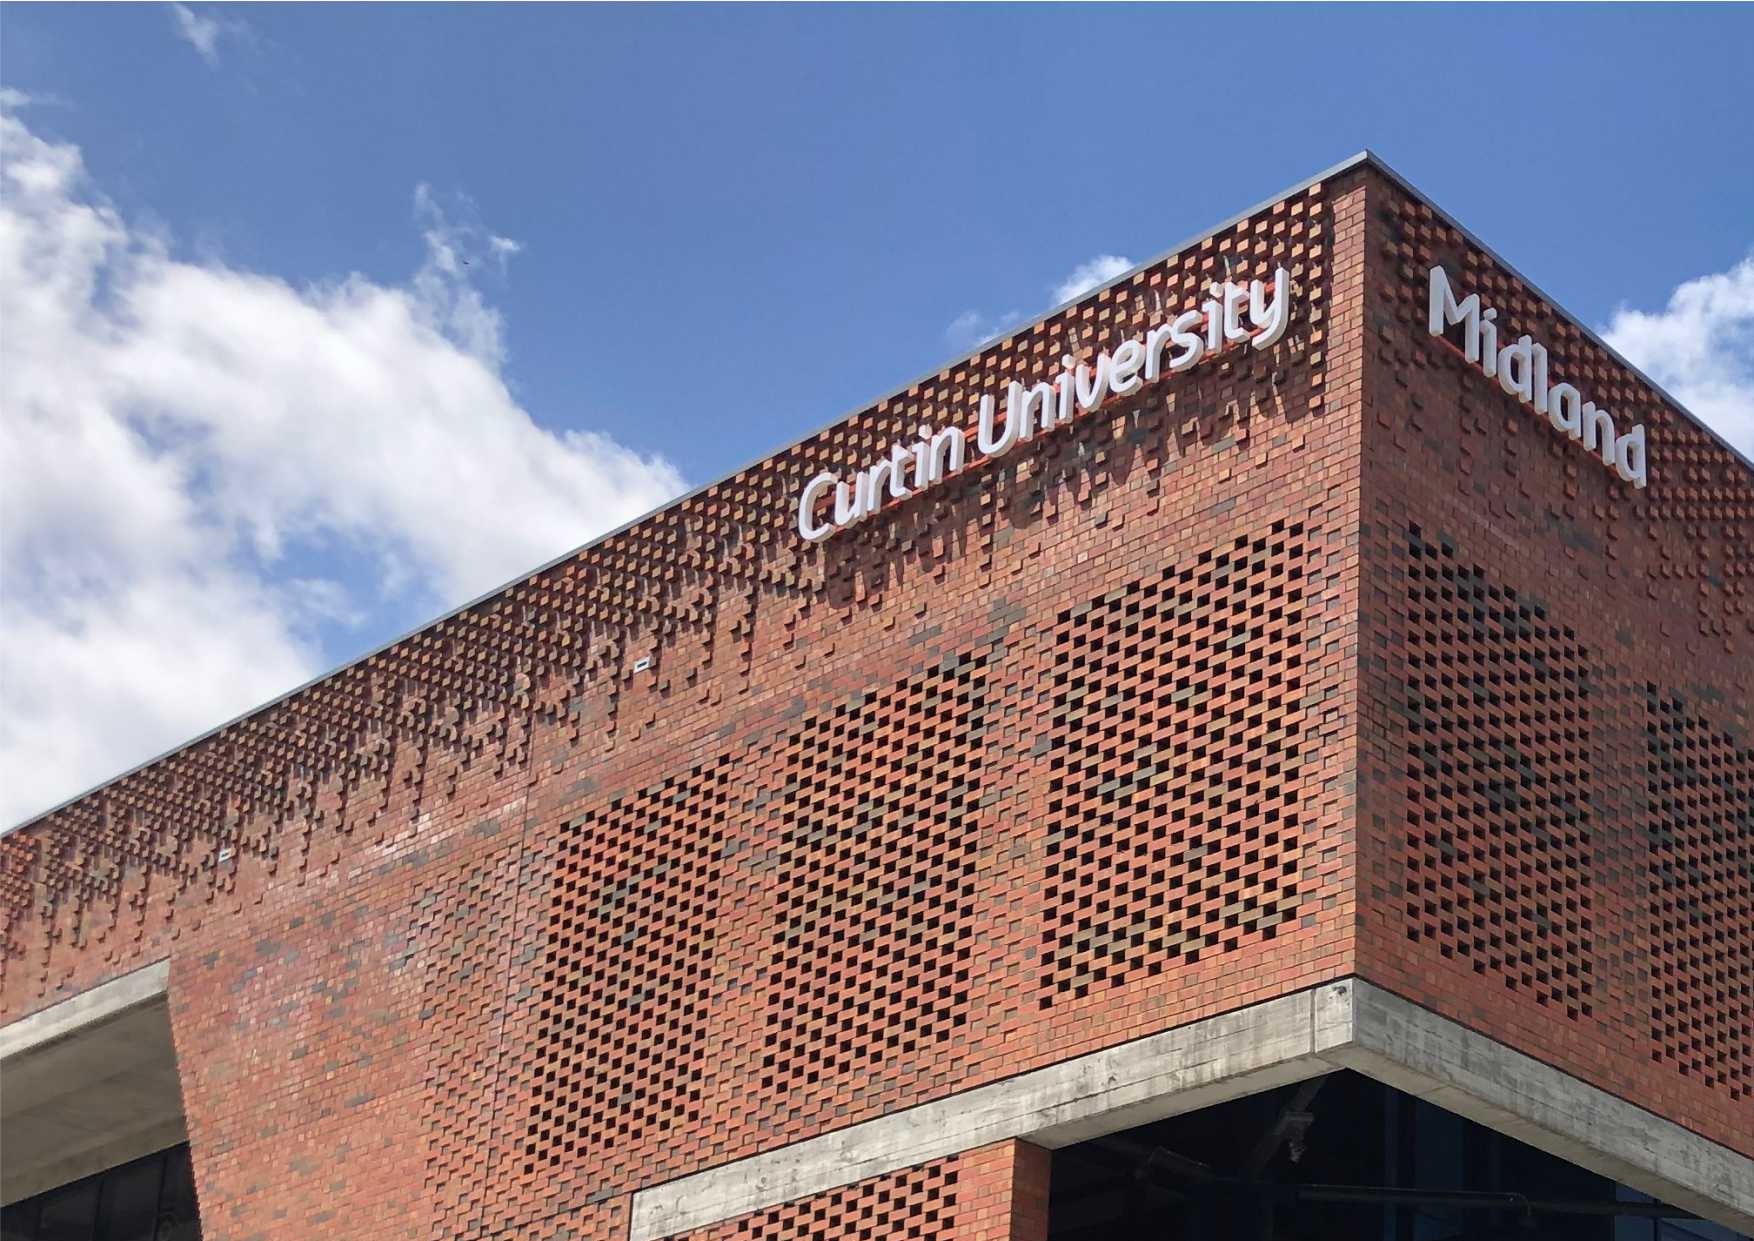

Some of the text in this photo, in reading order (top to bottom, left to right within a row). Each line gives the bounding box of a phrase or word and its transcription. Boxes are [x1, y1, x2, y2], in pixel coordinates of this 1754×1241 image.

[798, 267, 1290, 543] Curtin University
[1428, 265, 1648, 489] Midland
